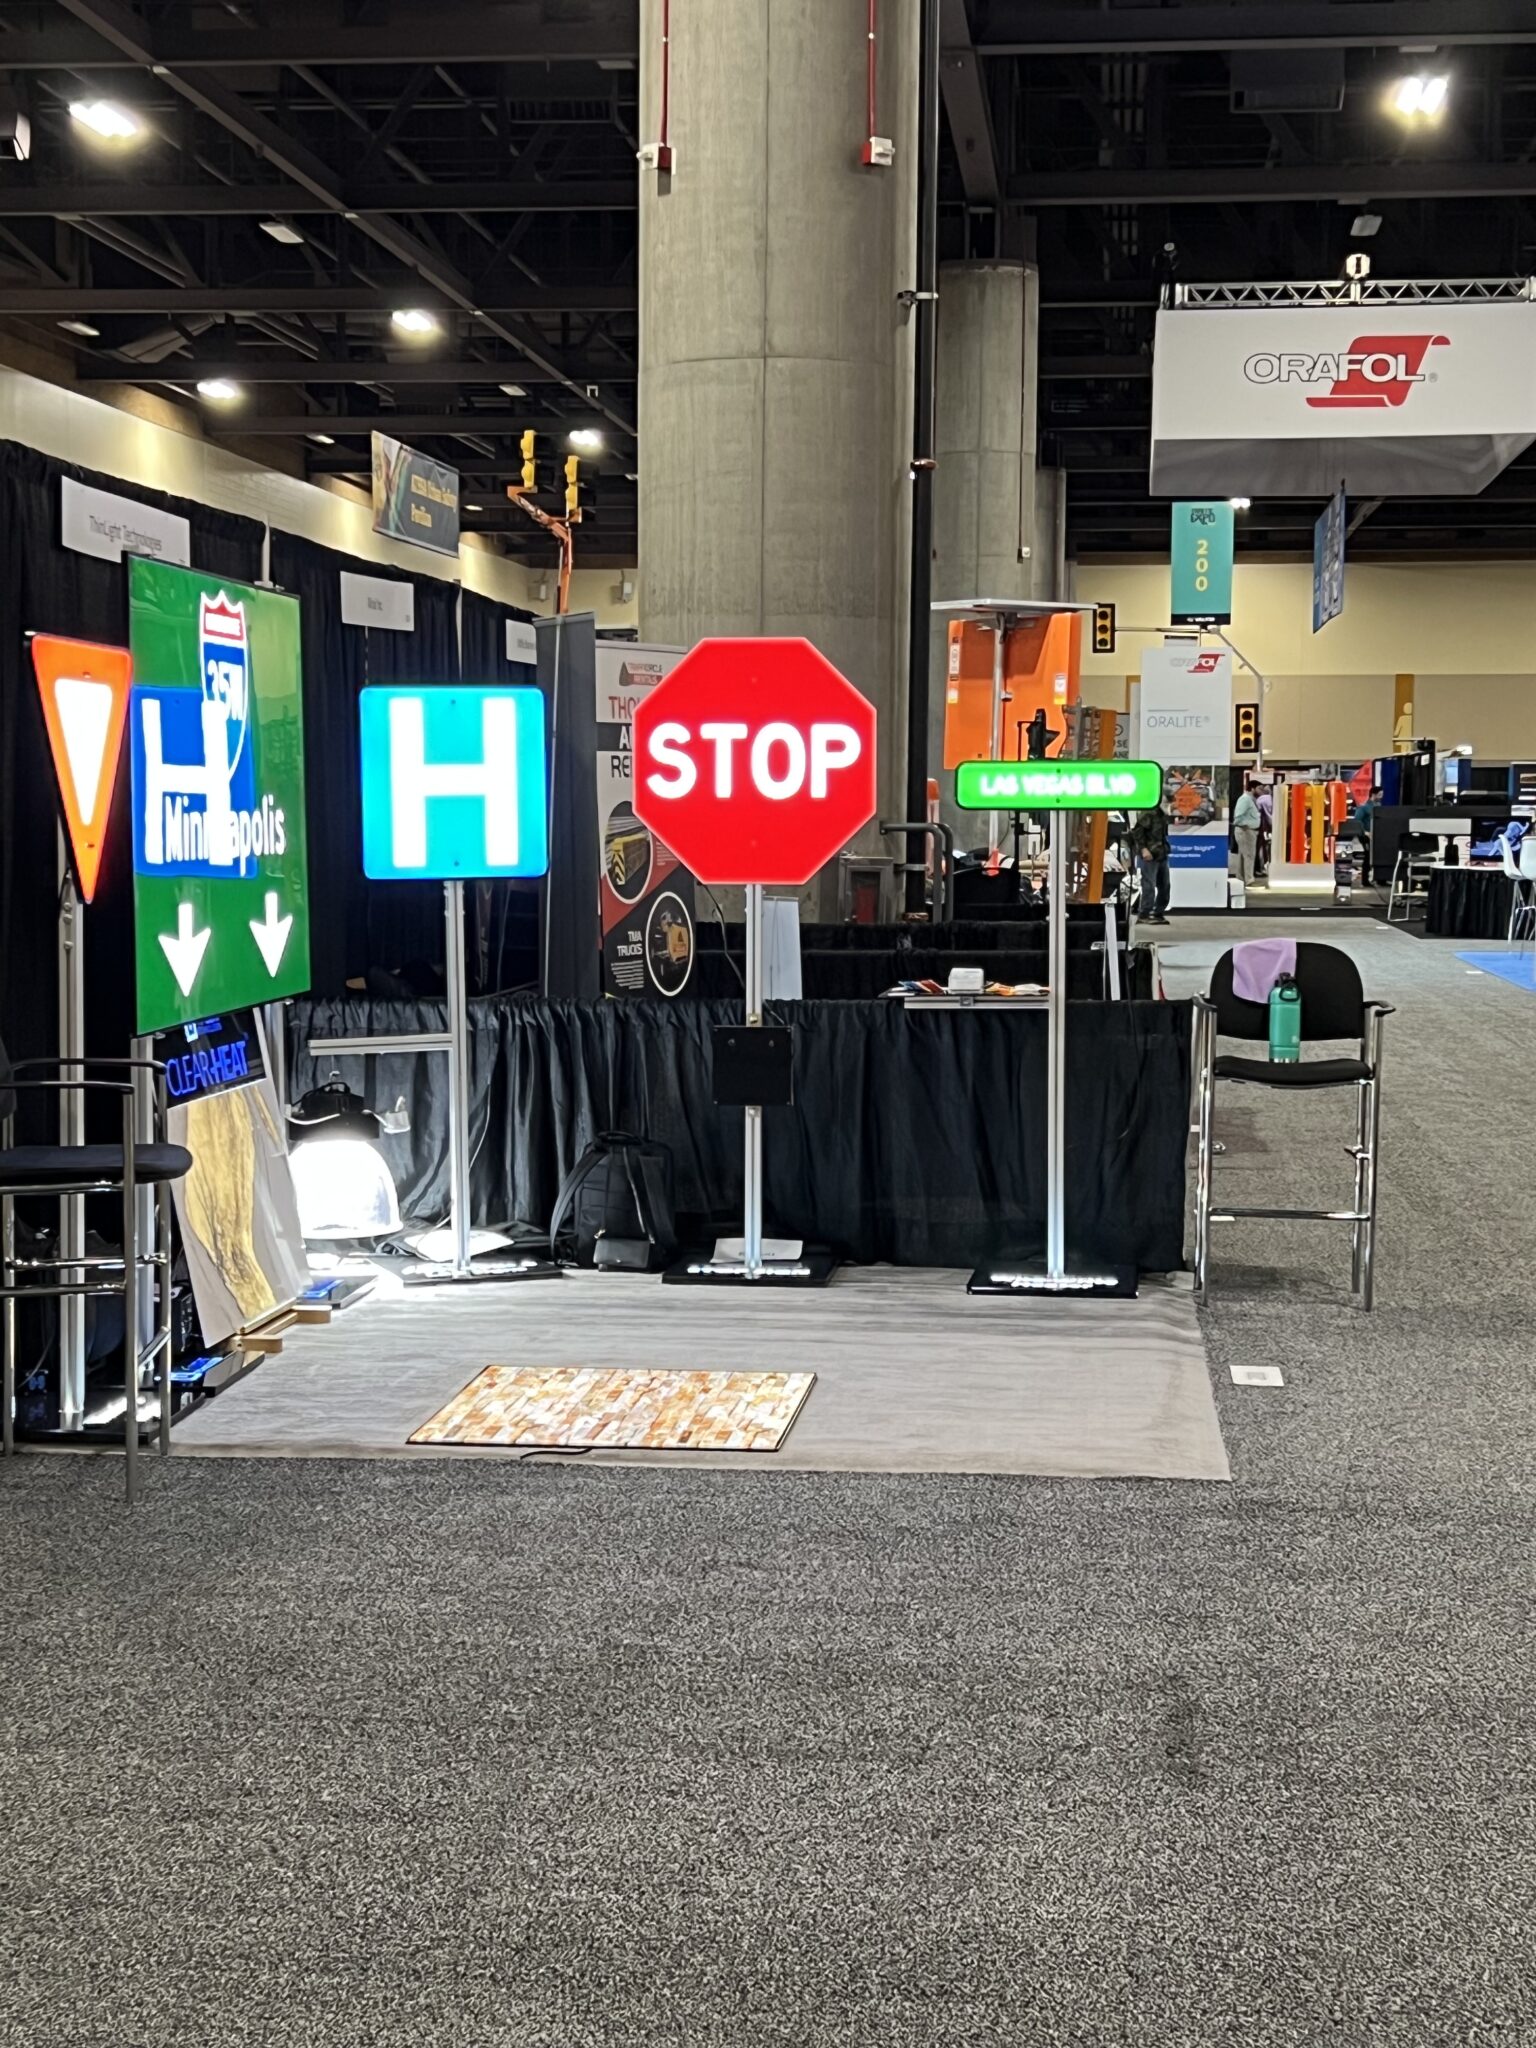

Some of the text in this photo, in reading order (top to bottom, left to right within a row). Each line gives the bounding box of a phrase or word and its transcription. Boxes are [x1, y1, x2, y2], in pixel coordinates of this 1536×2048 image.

[1195, 540, 1208, 591] 200
[389, 697, 519, 868] H
[646, 722, 861, 799] STOP
[980, 773, 1136, 796] LAS VEGAS BLVD
